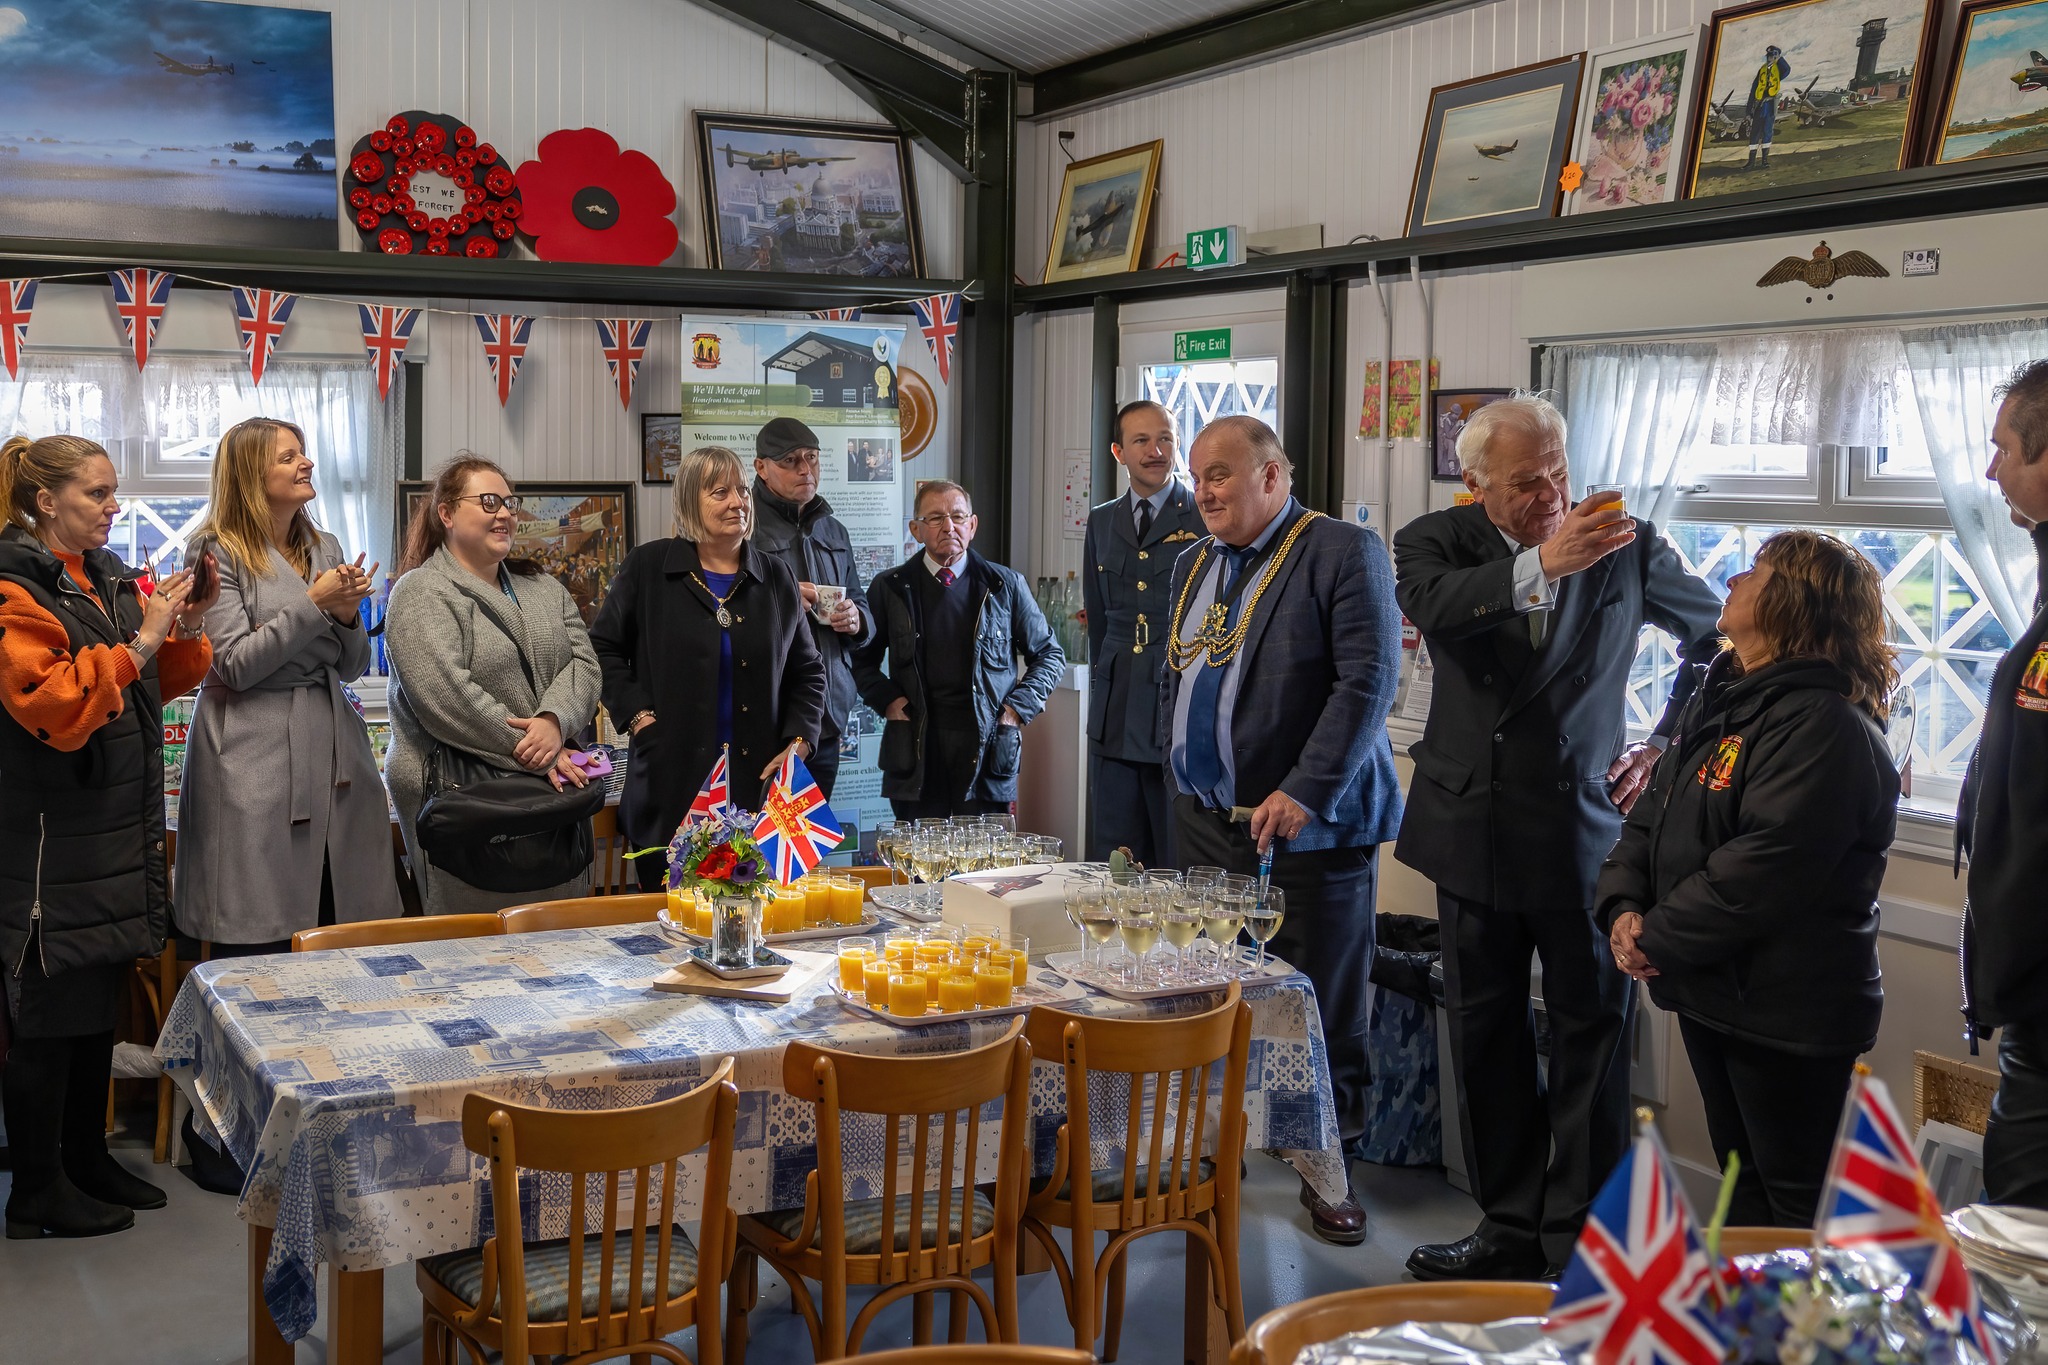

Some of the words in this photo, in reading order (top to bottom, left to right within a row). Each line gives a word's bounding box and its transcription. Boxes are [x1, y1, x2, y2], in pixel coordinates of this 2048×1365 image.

[409, 184, 431, 194] EST
[441, 189, 455, 198] WE
[418, 200, 456, 213] FORGET.
[1189, 340, 1206, 352] Fire
[1208, 337, 1226, 351] Exit
[693, 385, 714, 395] We'll
[715, 386, 736, 395] Meet
[736, 386, 761, 397] Again
[692, 396, 722, 405] Homefront
[694, 433, 727, 442] Welcome
[729, 433, 737, 442] to
